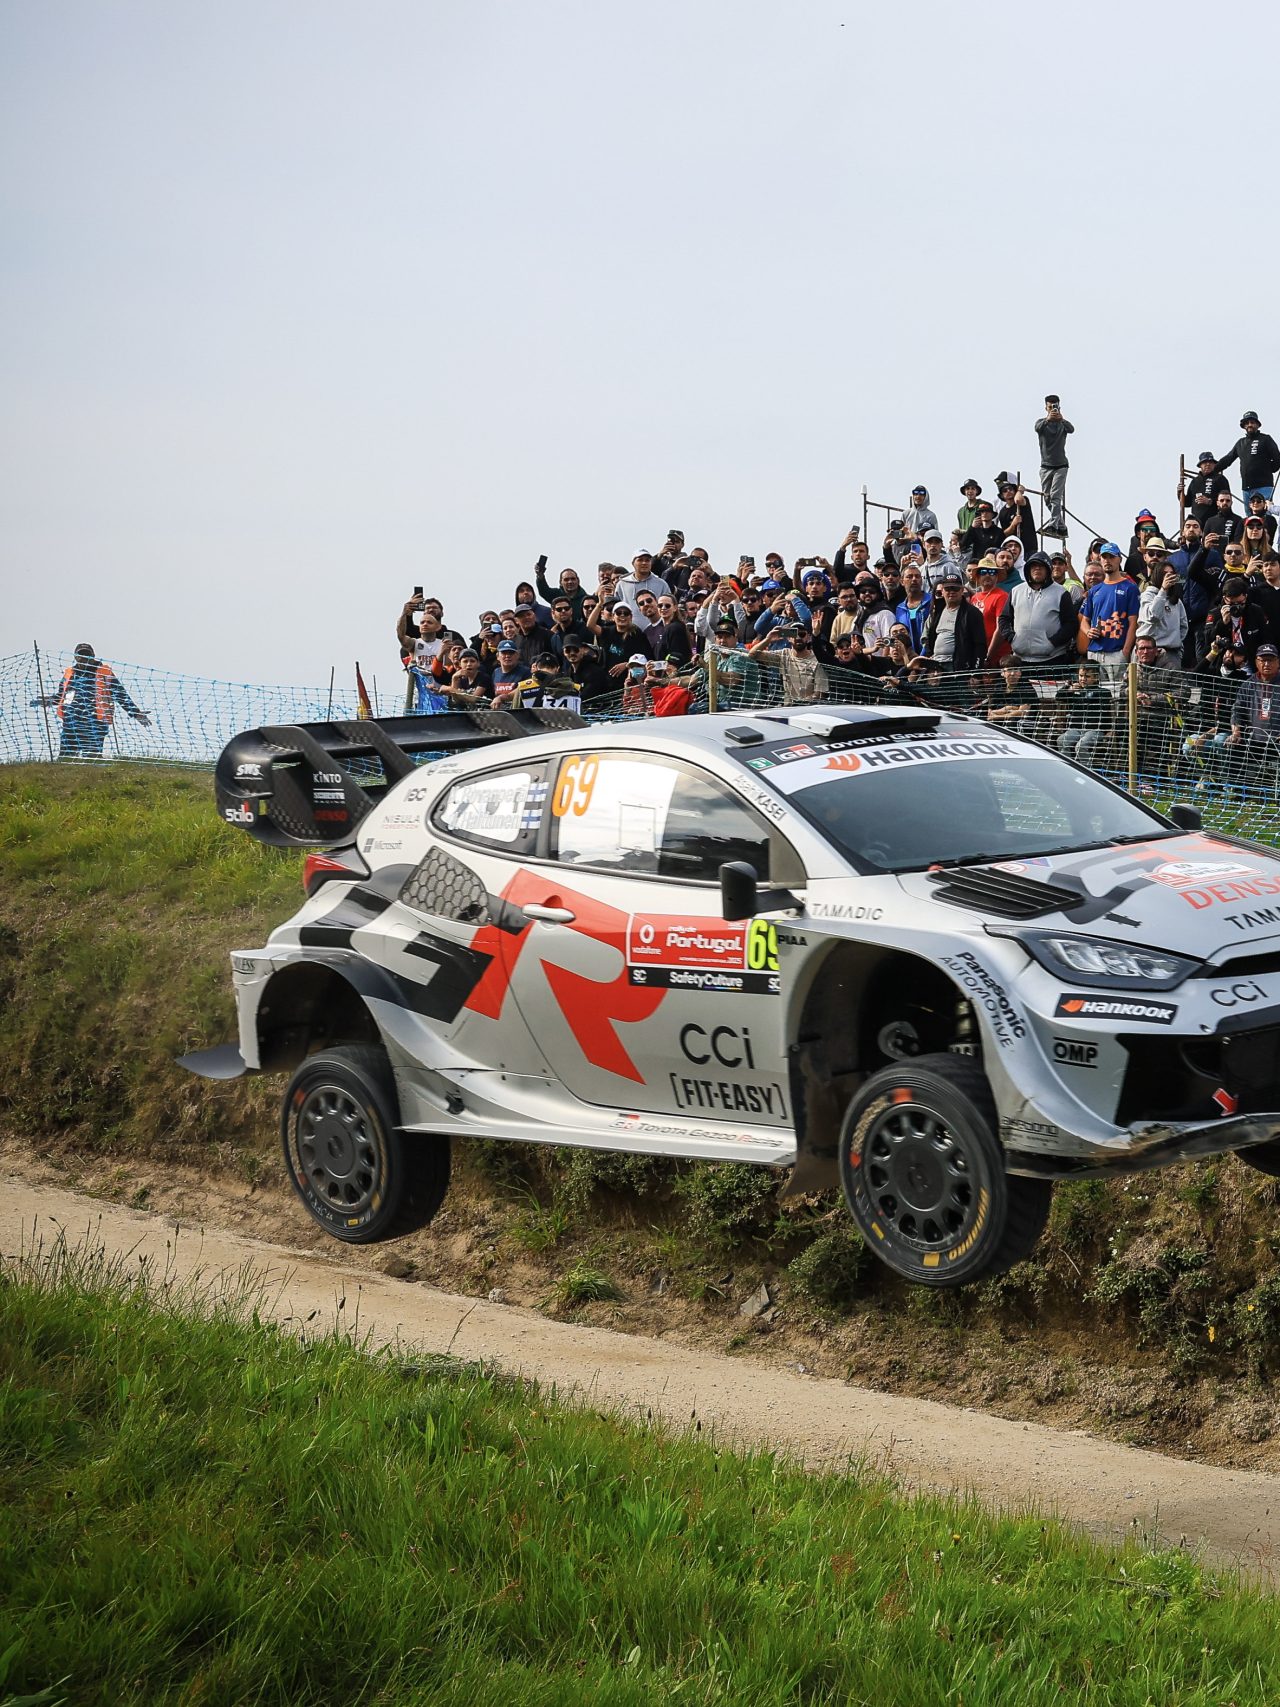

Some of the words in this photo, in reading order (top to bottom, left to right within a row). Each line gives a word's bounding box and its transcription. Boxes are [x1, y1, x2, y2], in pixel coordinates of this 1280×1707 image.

[814, 735, 889, 752] TOYOTA
[552, 754, 600, 818] 69
[812, 903, 884, 921] TAMADIC
[632, 945, 662, 955] vodafone
[666, 933, 743, 953] Portugal
[778, 934, 808, 947] PIAA
[669, 971, 744, 988] SafetyCulture
[938, 956, 1014, 1049] AUTOMOTIVE
[955, 951, 1026, 1039] Panasonic
[679, 1022, 755, 1070] CCi
[1053, 1042, 1098, 1063] OMP
[637, 1122, 688, 1136] TOYOTA
